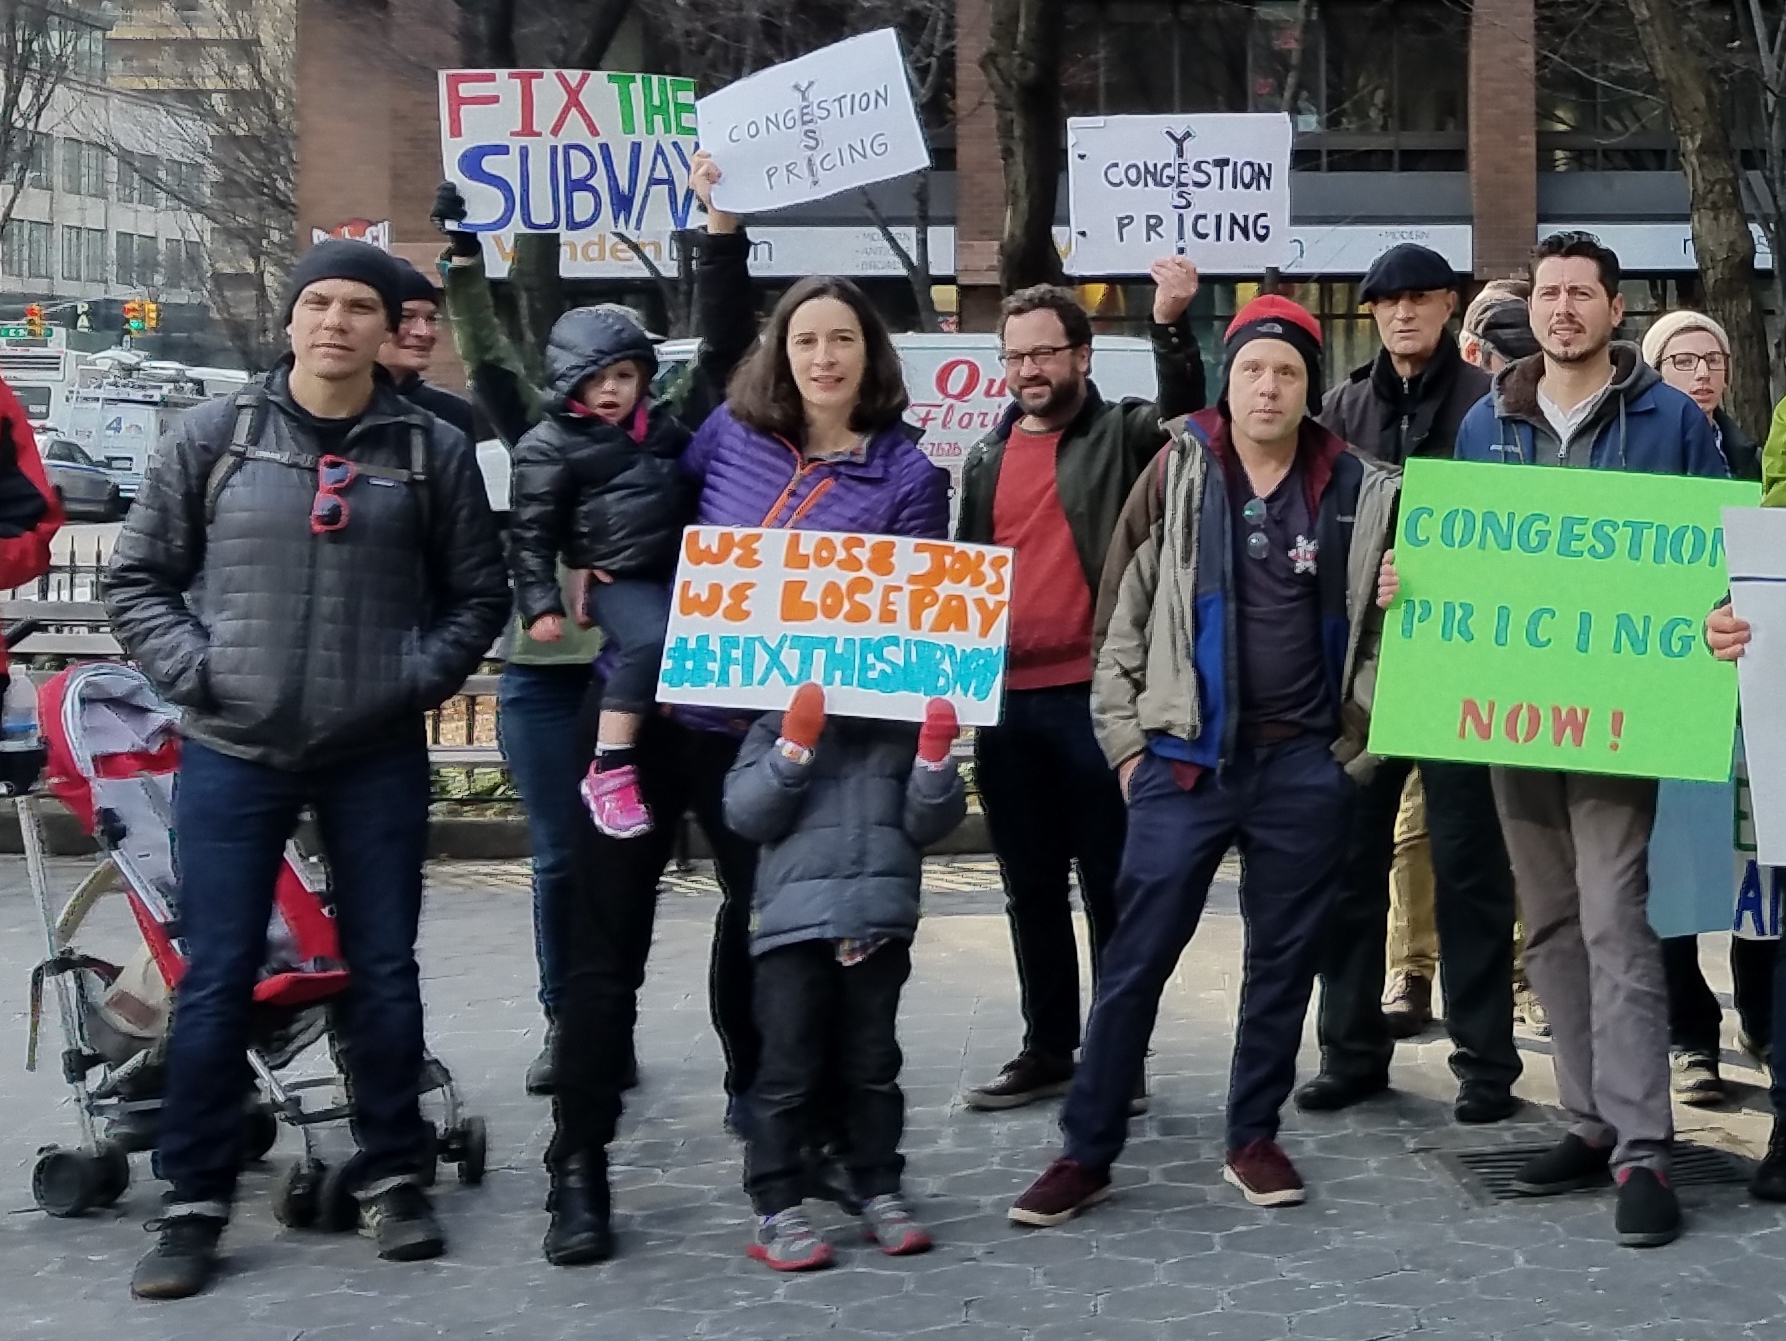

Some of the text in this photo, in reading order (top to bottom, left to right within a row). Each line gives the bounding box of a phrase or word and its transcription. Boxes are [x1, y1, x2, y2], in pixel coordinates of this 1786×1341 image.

[444, 71, 698, 138] FIX THE
[727, 83, 888, 144] CONGESTION
[457, 141, 701, 231] SUBWAY
[765, 132, 888, 190] PRICING
[1103, 156, 1273, 192] CONGESTION
[1115, 212, 1271, 243] PRICING
[105, 416, 123, 434] 4
[685, 530, 763, 568] WE
[784, 533, 896, 577] LOSE
[678, 576, 1007, 639] WE LOSE PAY
[1401, 599, 1697, 659] PRICING
